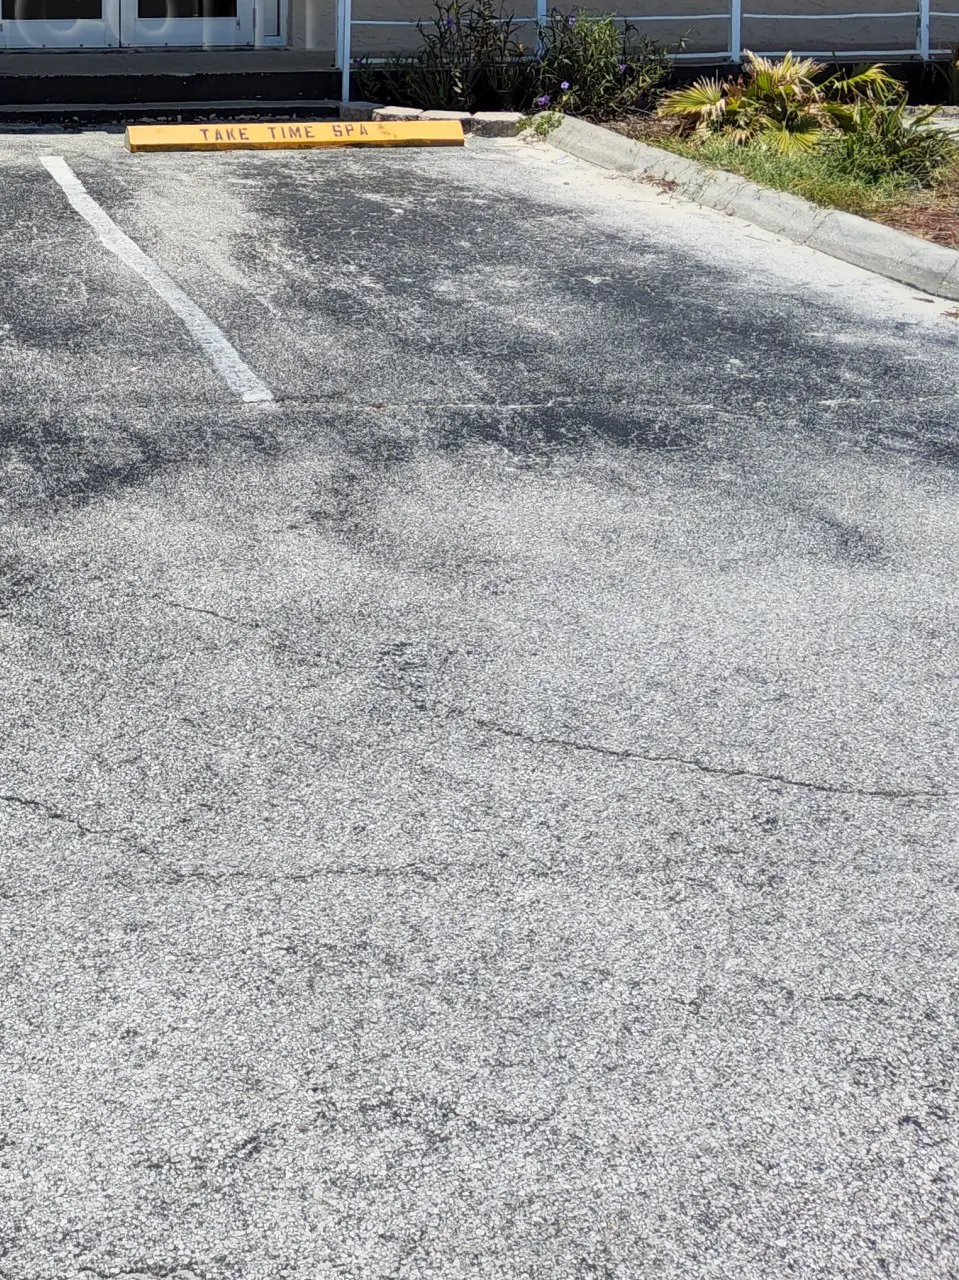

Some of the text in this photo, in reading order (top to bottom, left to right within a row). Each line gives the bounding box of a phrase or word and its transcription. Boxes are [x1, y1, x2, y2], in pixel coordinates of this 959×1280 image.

[199, 123, 368, 142] TAKE TIME SPA
